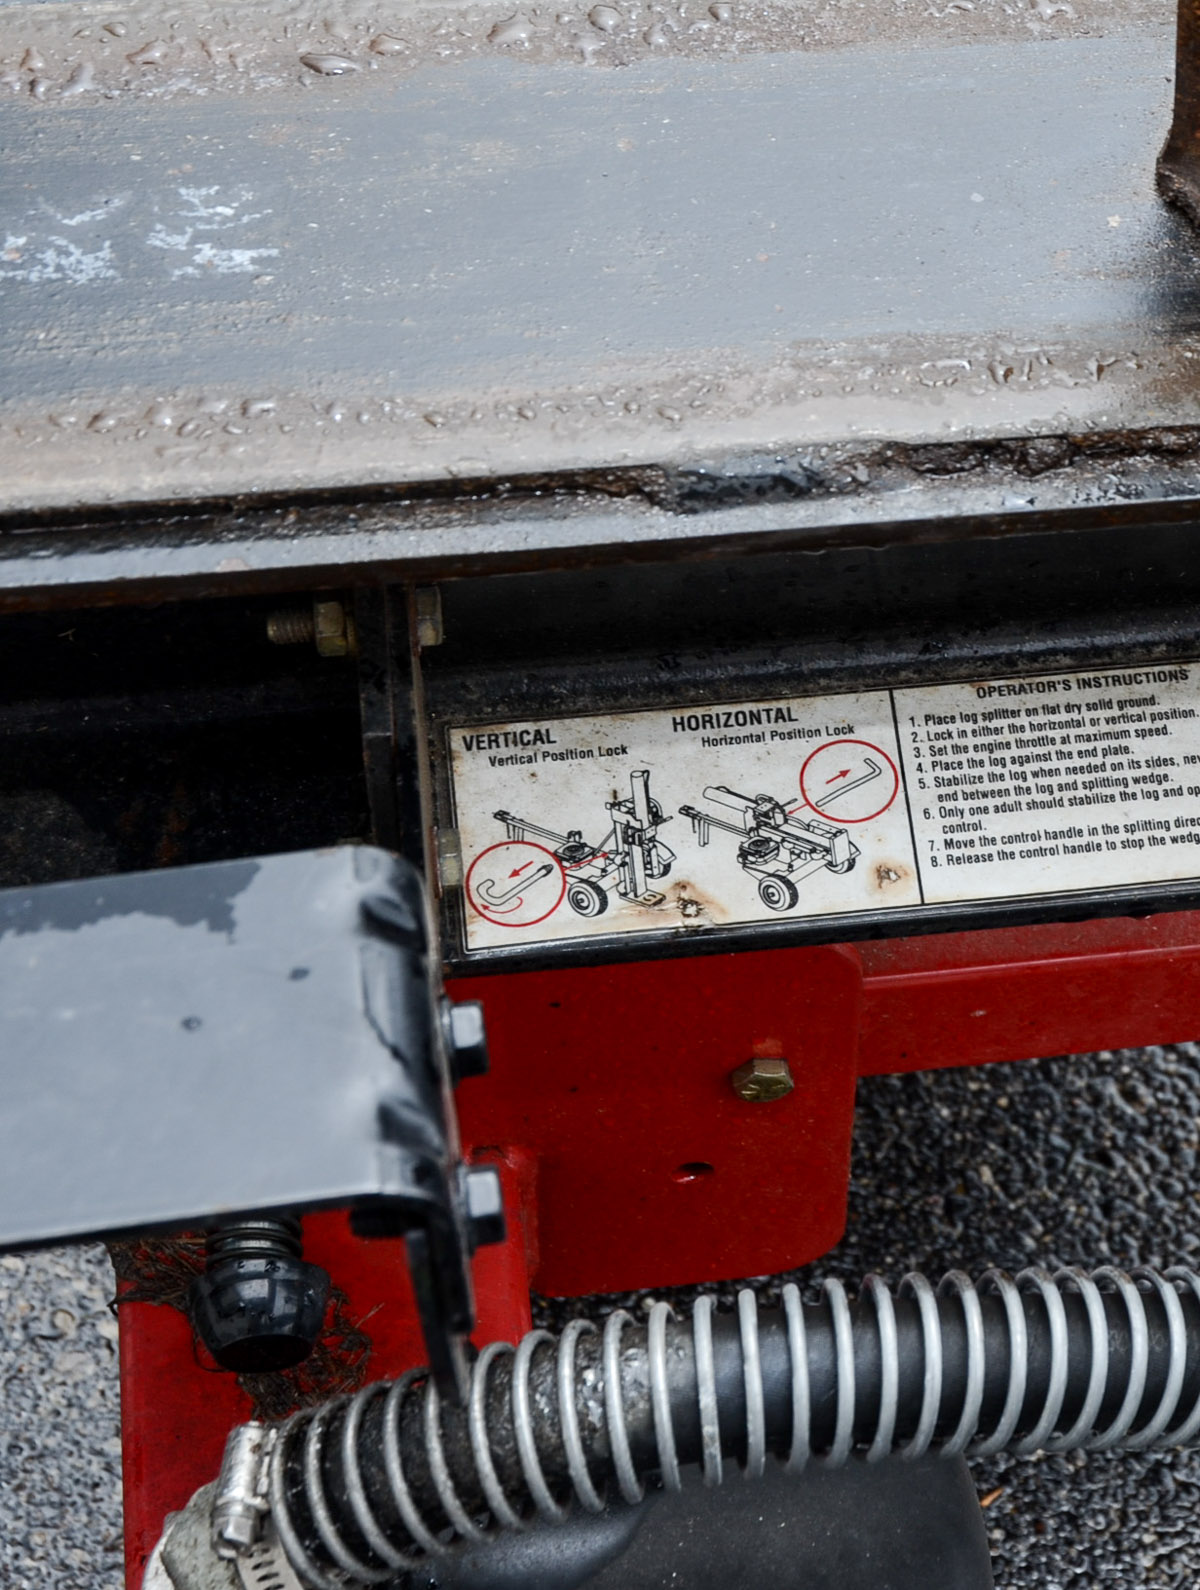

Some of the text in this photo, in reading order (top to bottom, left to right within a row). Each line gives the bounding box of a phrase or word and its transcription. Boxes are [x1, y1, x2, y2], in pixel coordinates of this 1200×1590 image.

[977, 668, 1189, 699] OPERATOR'S INSTRUCTIONS
[672, 707, 799, 733] HORIZONTAL
[908, 694, 1161, 727] 1. Place log splitter on flat dry solid ground.
[911, 707, 1200, 743] 2. Lock in either the horizontal or vertical position.
[462, 728, 557, 752] VERTICAL
[701, 723, 854, 747] Horizontal Position Lock
[913, 724, 1173, 758] 3. Set the engine throttle at maximum speed.
[488, 744, 628, 767] Vertical Position Lock
[916, 744, 1135, 773] 4. Place the log against the end plate.
[918, 777, 930, 789] 5.
[933, 773, 984, 788] Stabilize
[987, 771, 1005, 783] the
[1008, 769, 1027, 782] log
[1030, 766, 1061, 778] when
[1064, 761, 1106, 775] needed
[1110, 761, 1124, 771] on
[1127, 758, 1141, 769] its
[1144, 755, 1180, 768] sides,
[937, 772, 1174, 802] end between the log and splitting wedge.
[923, 807, 935, 819] 6.
[938, 806, 964, 819] Only
[968, 805, 989, 816] one
[993, 800, 1022, 813] adult
[1025, 796, 1064, 810] should
[1067, 793, 1116, 807] stabilize
[1119, 790, 1137, 801] the
[1140, 788, 1159, 801] log
[1162, 785, 1183, 797] and
[928, 840, 940, 851] 7.
[943, 838, 975, 850] Move
[978, 835, 997, 847] the
[1000, 830, 1041, 845] control
[1043, 826, 1083, 840] handle
[1087, 827, 1098, 836] in
[1101, 823, 1119, 835] the
[1123, 819, 1170, 835] splitting
[942, 819, 988, 834] control.
[930, 855, 942, 867] 8.
[946, 853, 993, 865] Release
[997, 849, 1015, 861] the
[1019, 844, 1059, 858] control
[1062, 841, 1102, 854] handle
[1105, 840, 1116, 850] to
[1120, 838, 1144, 850] stop
[1147, 835, 1166, 846] the
